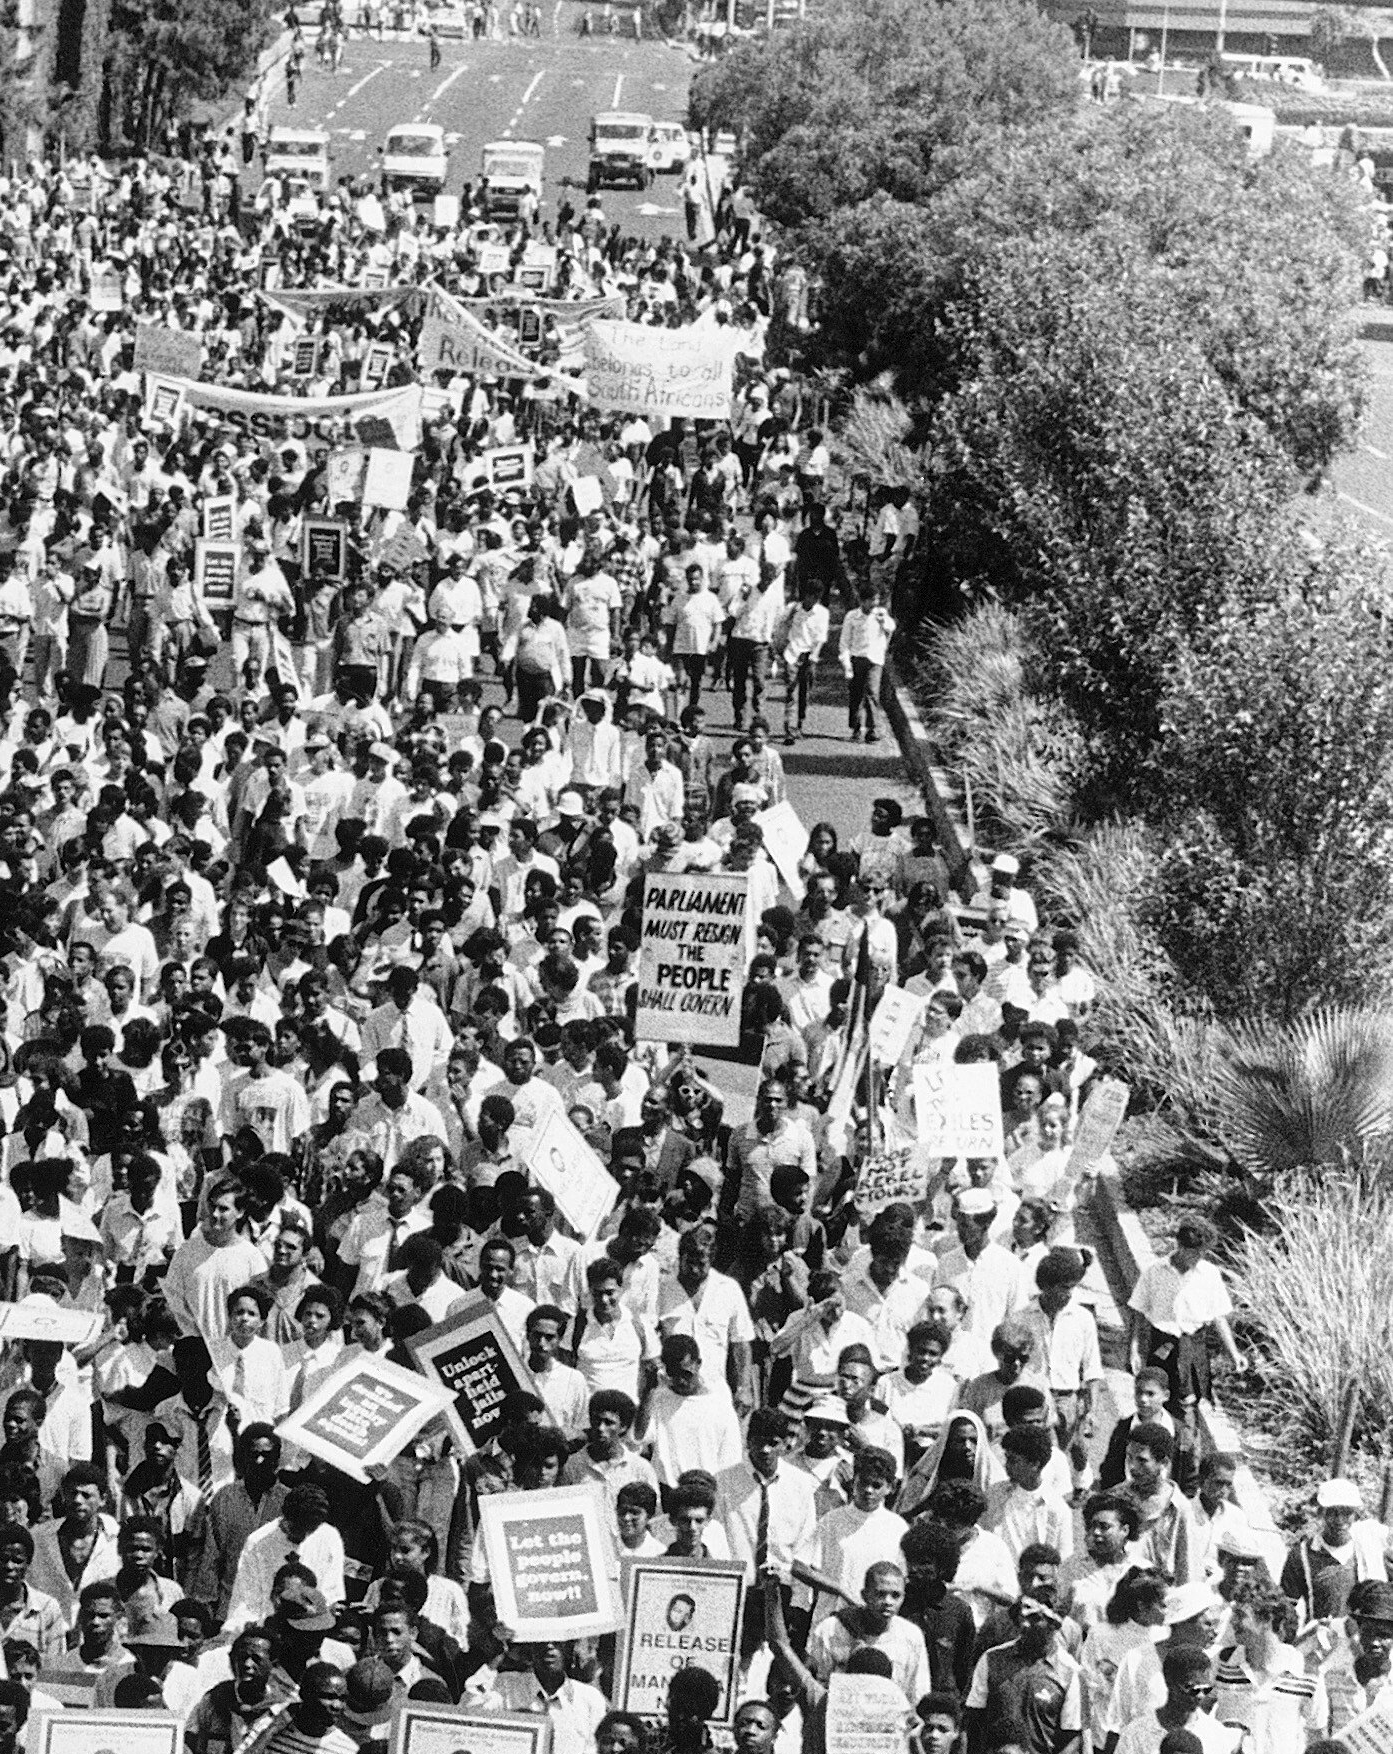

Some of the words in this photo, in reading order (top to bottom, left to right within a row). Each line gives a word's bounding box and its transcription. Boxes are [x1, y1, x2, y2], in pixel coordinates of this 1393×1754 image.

[668, 364, 691, 379] to
[700, 361, 723, 381] all
[645, 887, 748, 916] PARLIAMENT
[644, 919, 689, 940] MUST
[692, 922, 743, 945] RESIGN
[677, 944, 705, 962] THE
[657, 963, 732, 992] PEOPLE
[639, 989, 678, 1012] SHALL
[441, 1345, 498, 1379] Unlock
[454, 1361, 499, 1391] apart-
[464, 1374, 501, 1400] heid
[471, 1389, 507, 1416] jails
[510, 1533, 544, 1551] Let
[548, 1531, 582, 1548] the
[515, 1551, 583, 1570] people
[639, 1633, 730, 1653] RELEASE
[669, 1655, 696, 1670] OF
